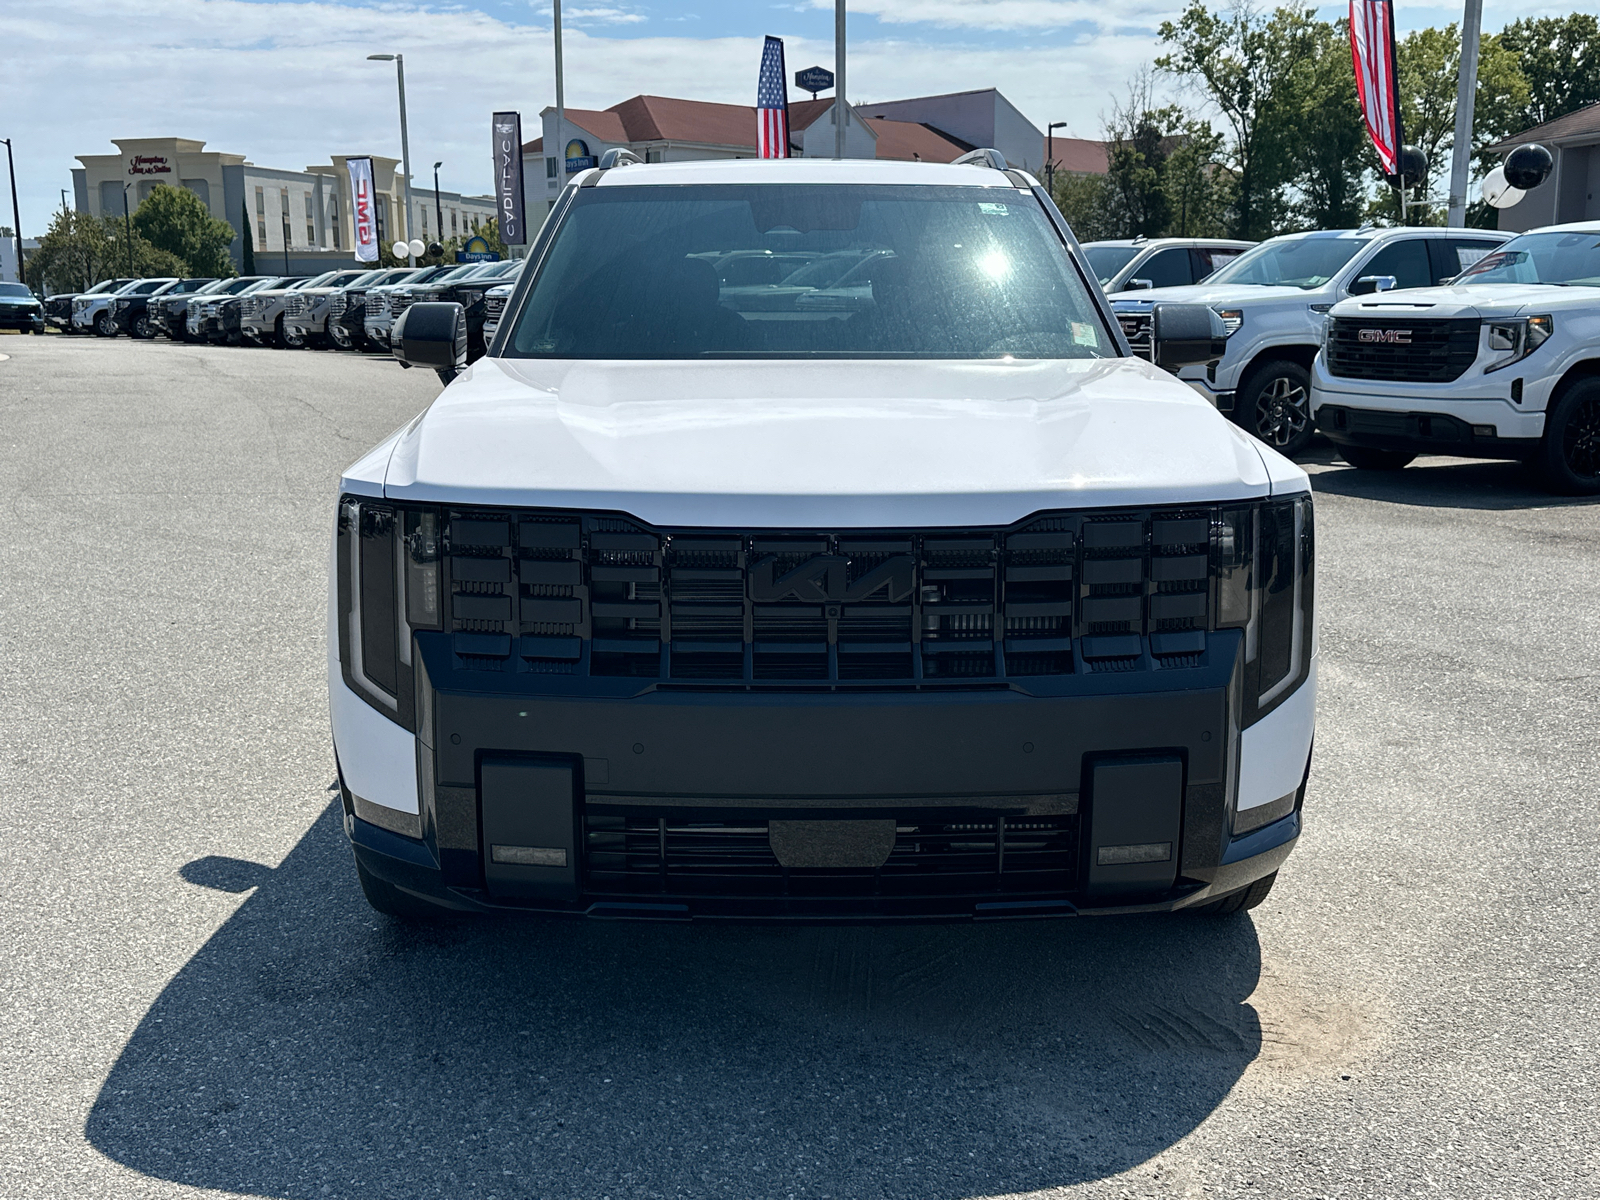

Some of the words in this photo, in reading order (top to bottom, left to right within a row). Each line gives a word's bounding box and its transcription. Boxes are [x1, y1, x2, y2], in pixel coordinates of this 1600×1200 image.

[130, 155, 167, 166] Hampton
[566, 160, 578, 168] ays
[465, 253, 481, 261] Days
[1358, 328, 1412, 343] GMC
